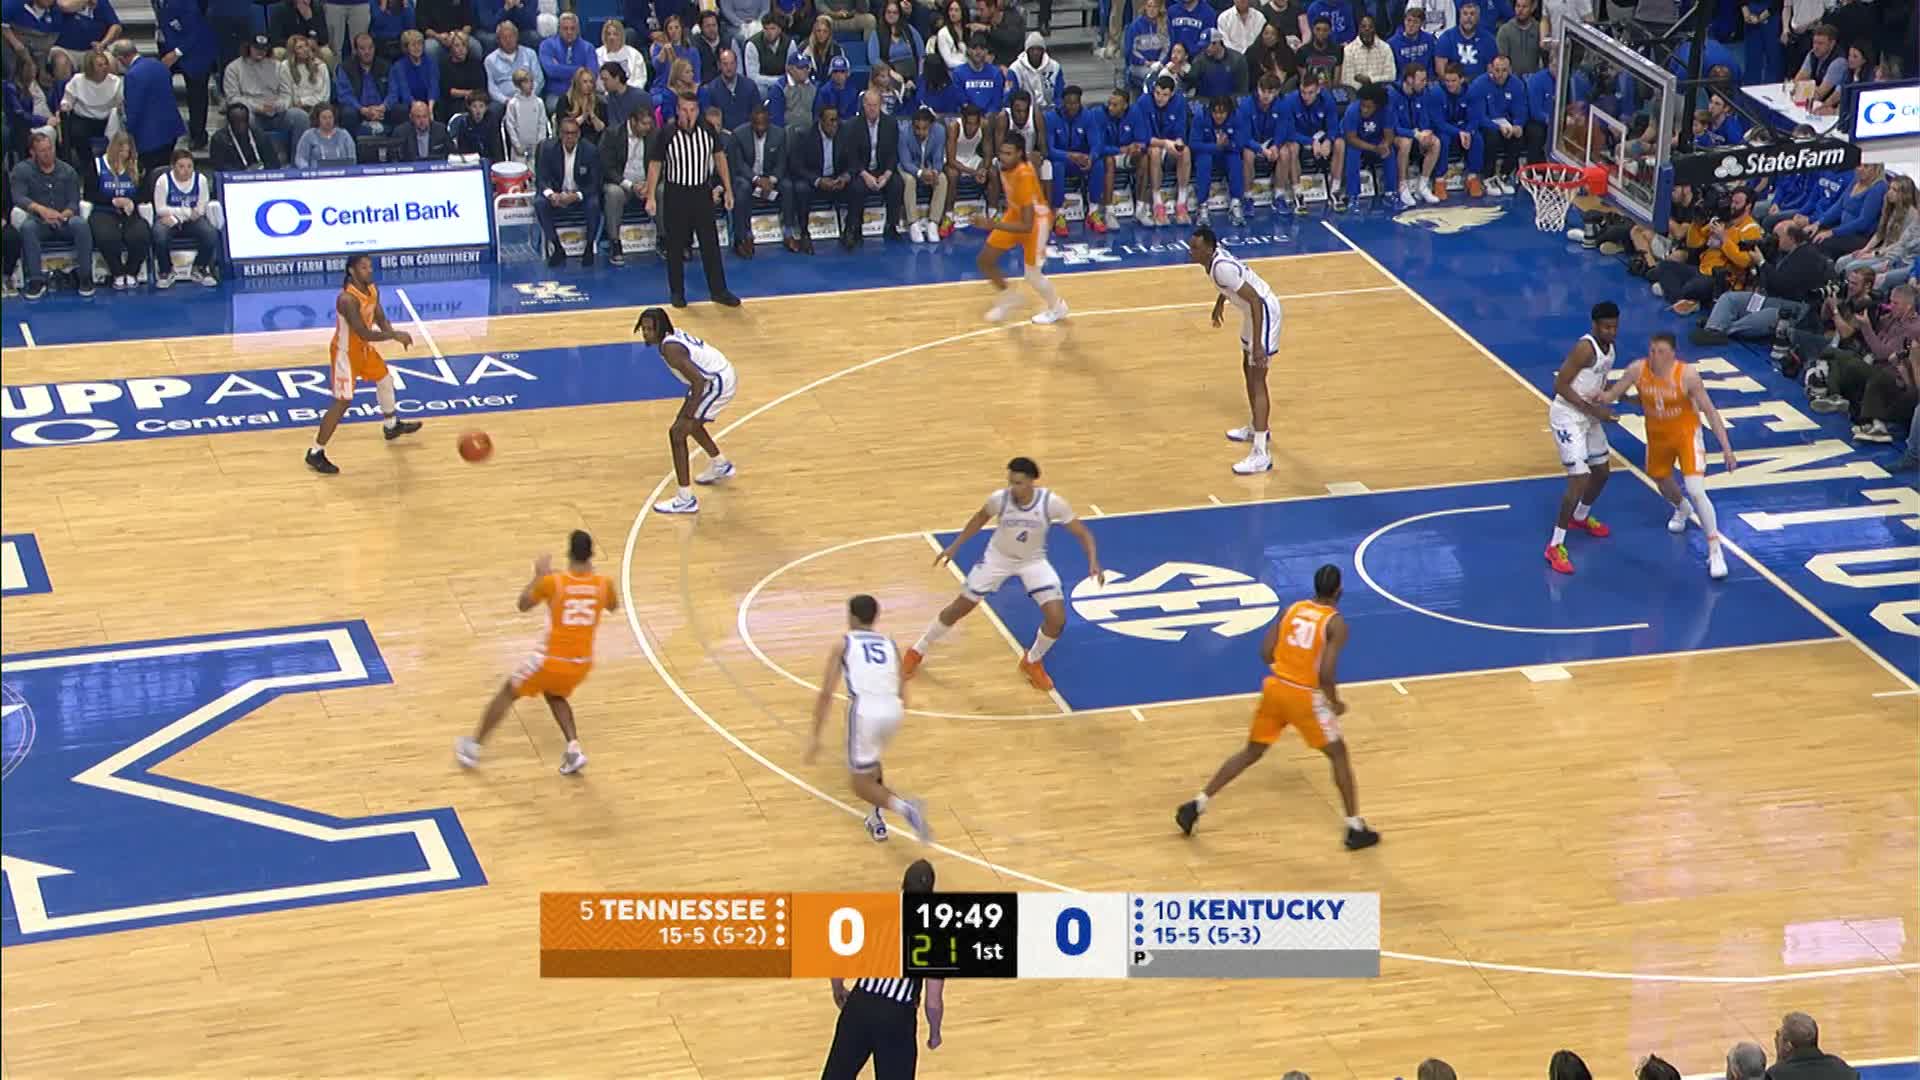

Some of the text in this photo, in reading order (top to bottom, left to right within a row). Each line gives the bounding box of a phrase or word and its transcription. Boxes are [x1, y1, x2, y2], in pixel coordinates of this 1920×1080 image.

[322, 200, 460, 226] Central Bank
[1122, 232, 1289, 254] HealCare
[243, 261, 294, 276] KENTUCKY
[296, 258, 323, 273] FARM
[380, 251, 480, 268] BIG ON COMMITMENT
[206, 355, 538, 404] ARNA
[135, 410, 279, 433] Central
[395, 392, 519, 413] Center
[1015, 530, 1028, 543] 4
[561, 597, 598, 626] 25
[1071, 562, 1280, 641] SEC
[1286, 617, 1316, 650] 30
[861, 642, 887, 664] 15
